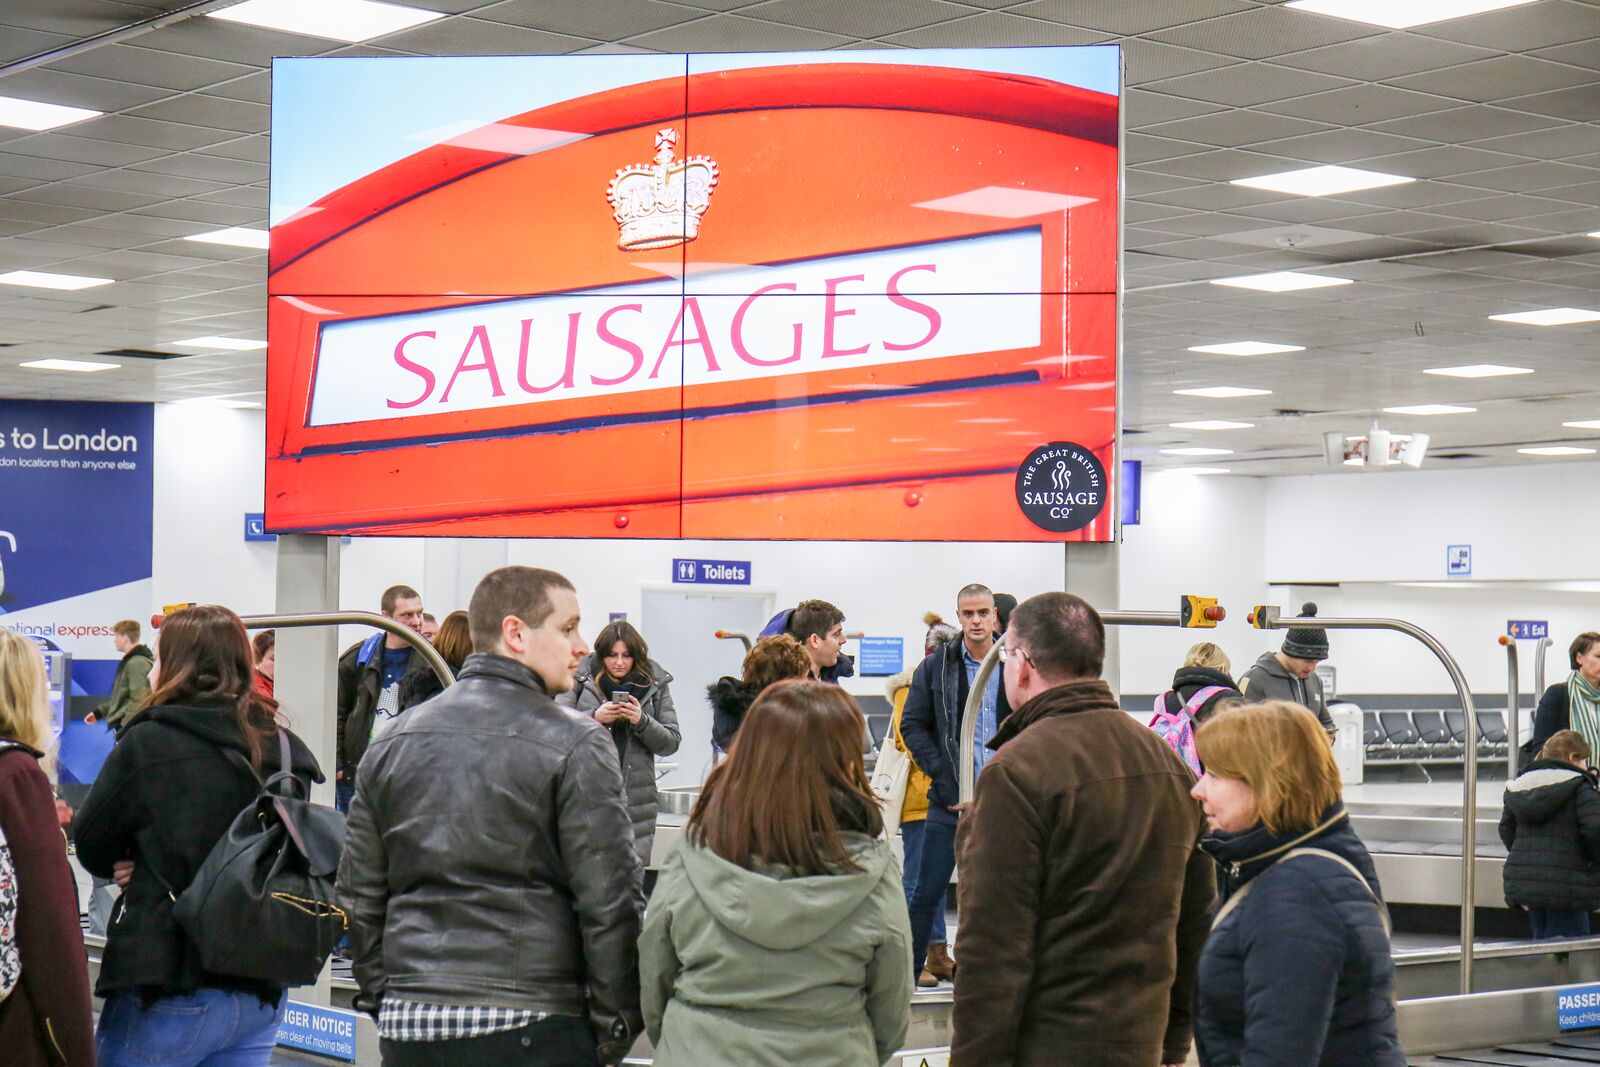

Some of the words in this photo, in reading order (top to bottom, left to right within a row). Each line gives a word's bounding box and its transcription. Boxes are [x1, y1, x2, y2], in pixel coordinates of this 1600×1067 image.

[387, 264, 942, 409] SAUSAGES
[11, 427, 36, 449] to
[43, 427, 137, 452] London
[19, 457, 59, 468] locations
[60, 458, 80, 468] than
[82, 461, 116, 470] anyone
[117, 461, 136, 470] else
[1023, 465, 1036, 486] THE
[1035, 449, 1068, 465] GREAT
[1071, 451, 1099, 487] BRITISH
[1023, 492, 1098, 505] SAUSAGE
[702, 564, 746, 580] Toilets
[0, 622, 55, 636] ational
[1531, 624, 1545, 636] Exit
[312, 1014, 352, 1038] NOTICE
[1559, 1014, 1577, 1026] Keep
[289, 1031, 305, 1043] clear
[305, 1034, 313, 1045] of
[312, 1036, 335, 1052] moving
[336, 1041, 352, 1054] belts
